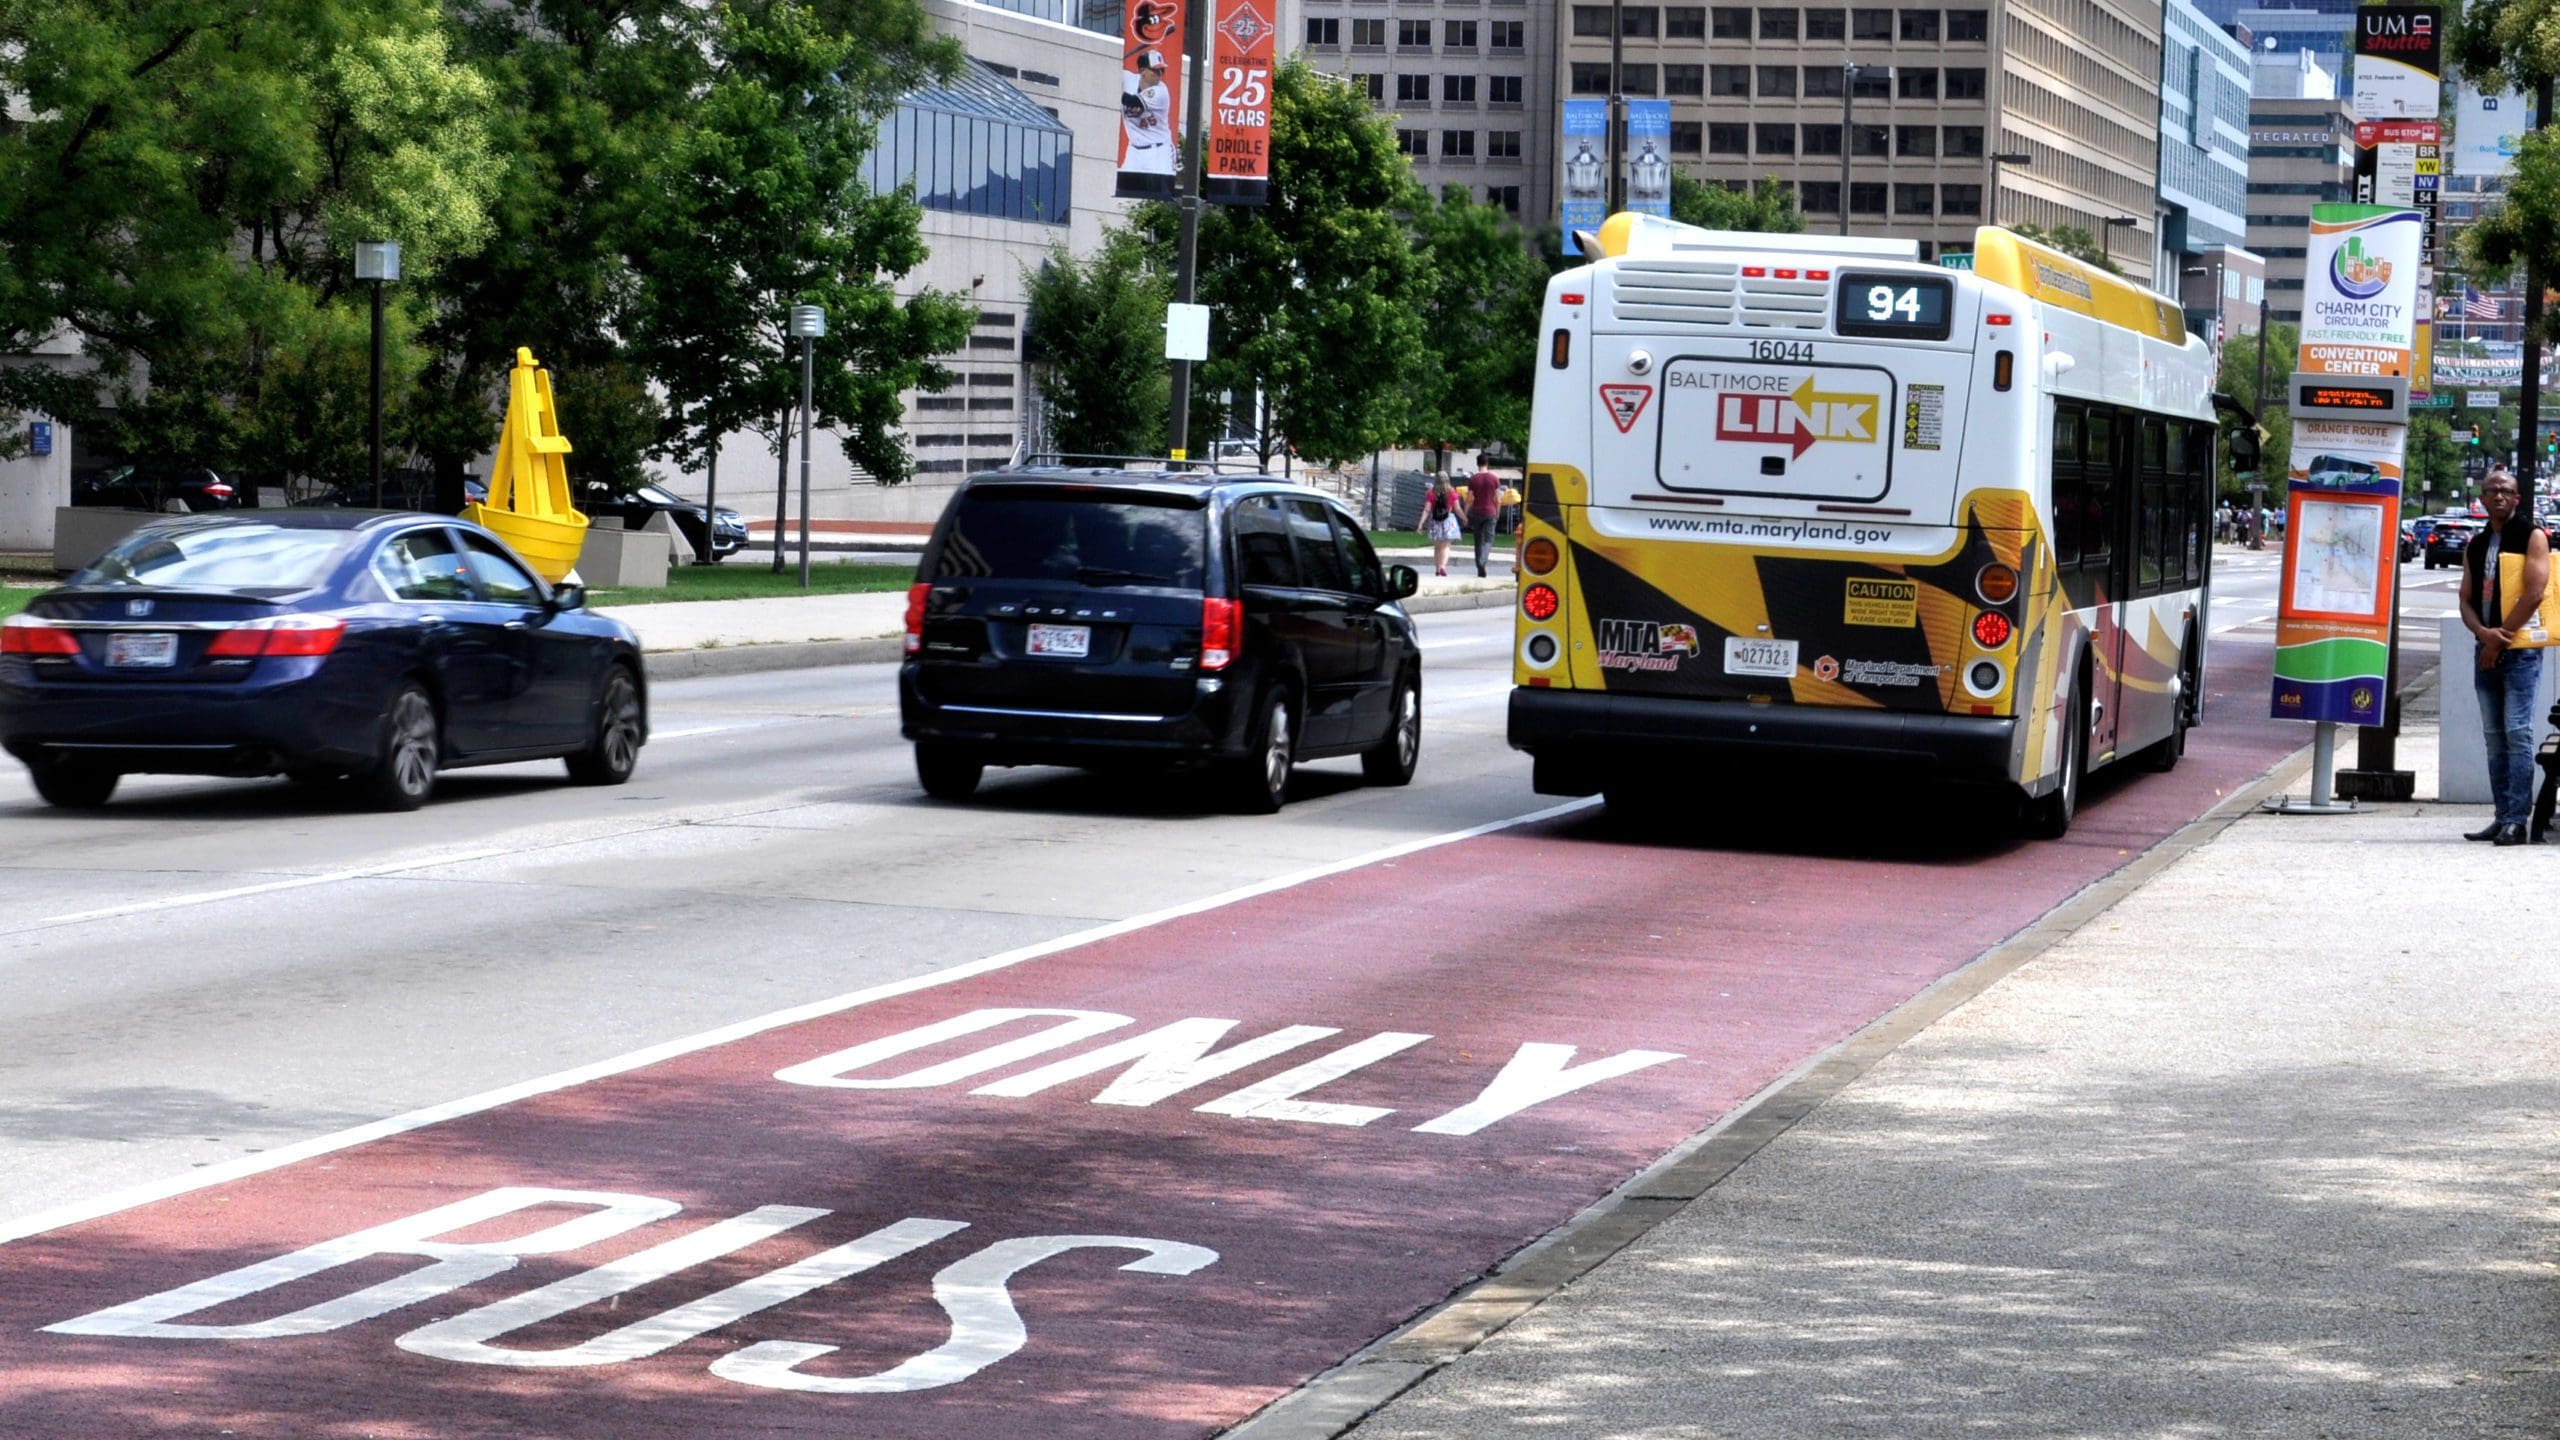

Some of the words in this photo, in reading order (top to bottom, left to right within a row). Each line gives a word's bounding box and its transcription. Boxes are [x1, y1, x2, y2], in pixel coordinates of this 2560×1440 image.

[2366, 15, 2407, 35] UM
[2366, 34, 2432, 50] shuttle
[1217, 67, 1268, 107] 25
[1217, 108, 1266, 127] YEARS
[2401, 129, 2421, 138] STOP
[1215, 137, 1263, 156] ORIOLE
[2420, 146, 2436, 157] BR
[1219, 156, 1257, 174] PARK
[2418, 161, 2436, 173] YW
[2418, 176, 2434, 188] NV
[2419, 191, 2432, 203] 54
[1867, 286, 1920, 322] 94
[2316, 302, 2365, 315] CHARM
[2370, 304, 2402, 318] CITY
[2325, 316, 2389, 328] CIRCULATOR
[2307, 329, 2329, 339] FAST.
[2331, 331, 2377, 342] FRIENDLY.
[2380, 333, 2407, 344] FREE.
[1748, 340, 1815, 362] 16044
[2310, 347, 2398, 364] CONVENTION
[2324, 361, 2380, 374] CENTER
[1670, 372, 1790, 392] BALTIMORE
[1722, 397, 1873, 439] LINK
[2308, 423, 2350, 435] ORANGE
[2352, 425, 2389, 438] ROUTE
[1649, 517, 1892, 545] www.mta.maryland.gov
[1850, 583, 1914, 599] CAUTION
[1600, 619, 1662, 656] MTA
[1597, 651, 1680, 672] Maryland
[1741, 648, 1781, 665] 02732
[1844, 659, 1888, 674] Maryland
[1888, 661, 1940, 676] Department
[1843, 672, 1857, 682] of
[1855, 672, 1920, 687] Transportation
[2279, 694, 2301, 705] dot
[772, 1006, 1686, 1138] ONLY
[40, 1187, 1220, 1396] BUS
